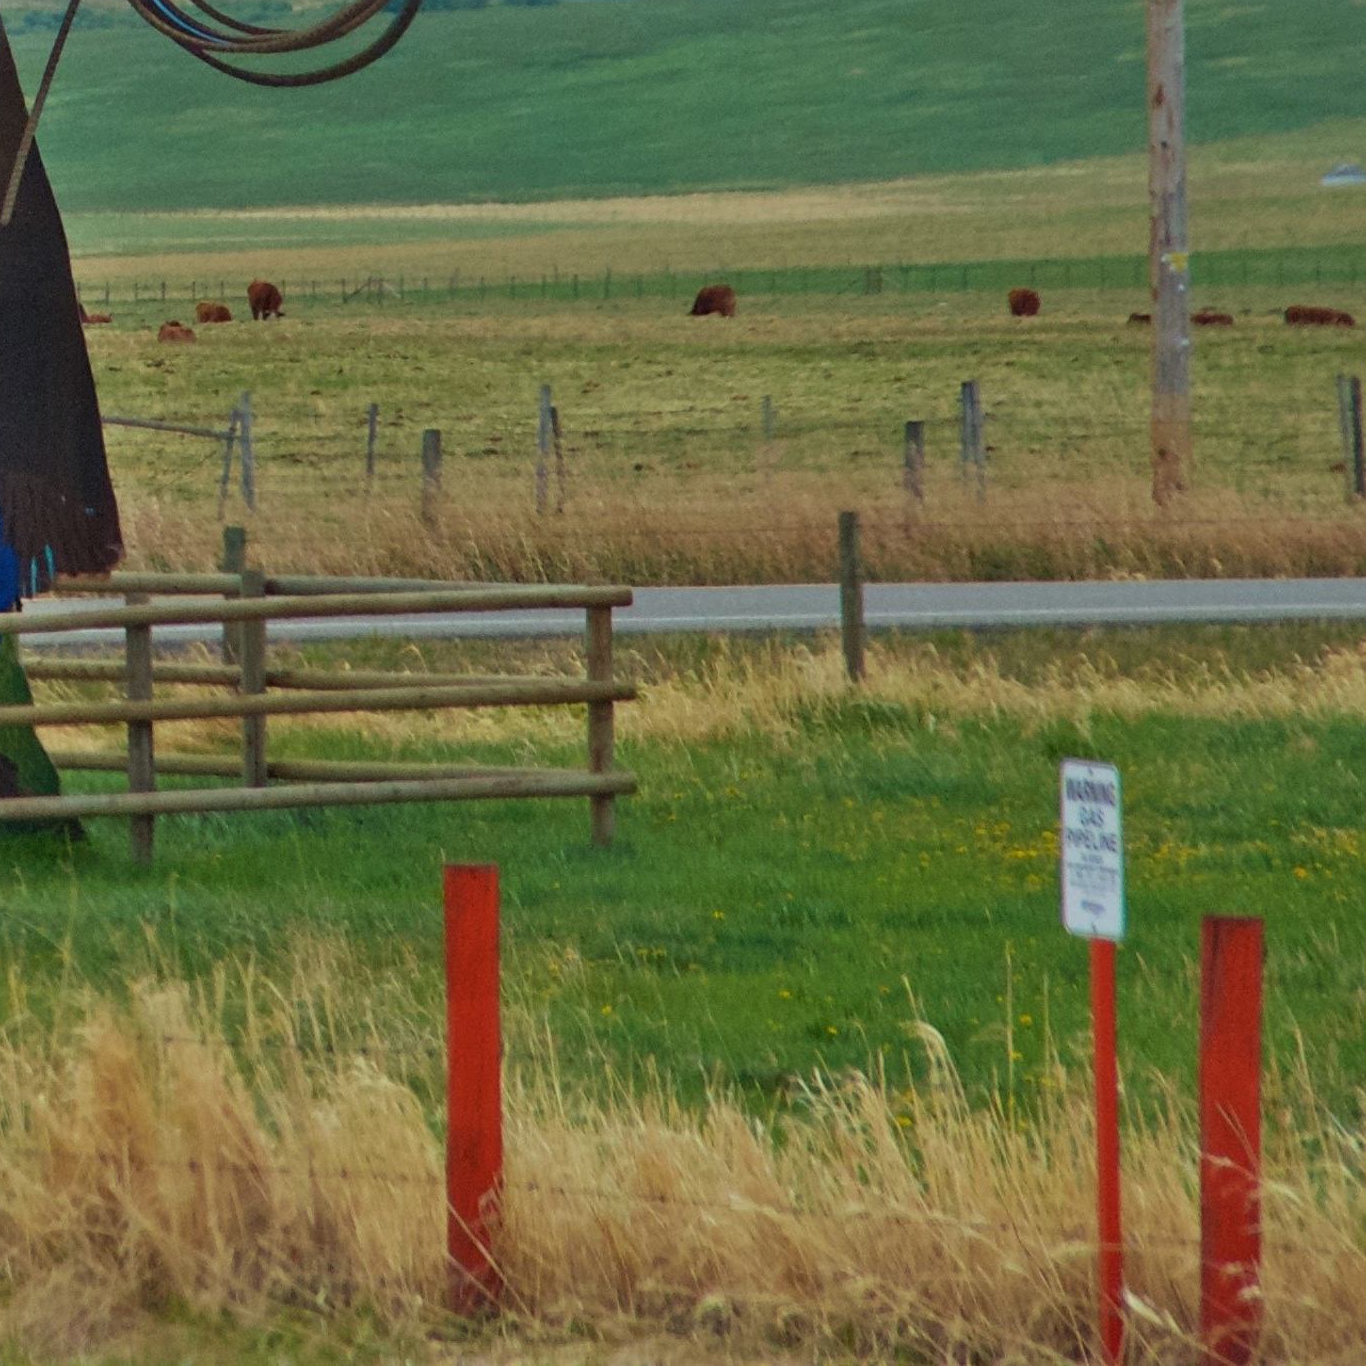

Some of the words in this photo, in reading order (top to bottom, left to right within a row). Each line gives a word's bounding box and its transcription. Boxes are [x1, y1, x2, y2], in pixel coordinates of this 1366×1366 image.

[1067, 779, 1116, 806] WARNING
[1080, 806, 1105, 829] GAS
[1067, 827, 1118, 854] PIPELINE
